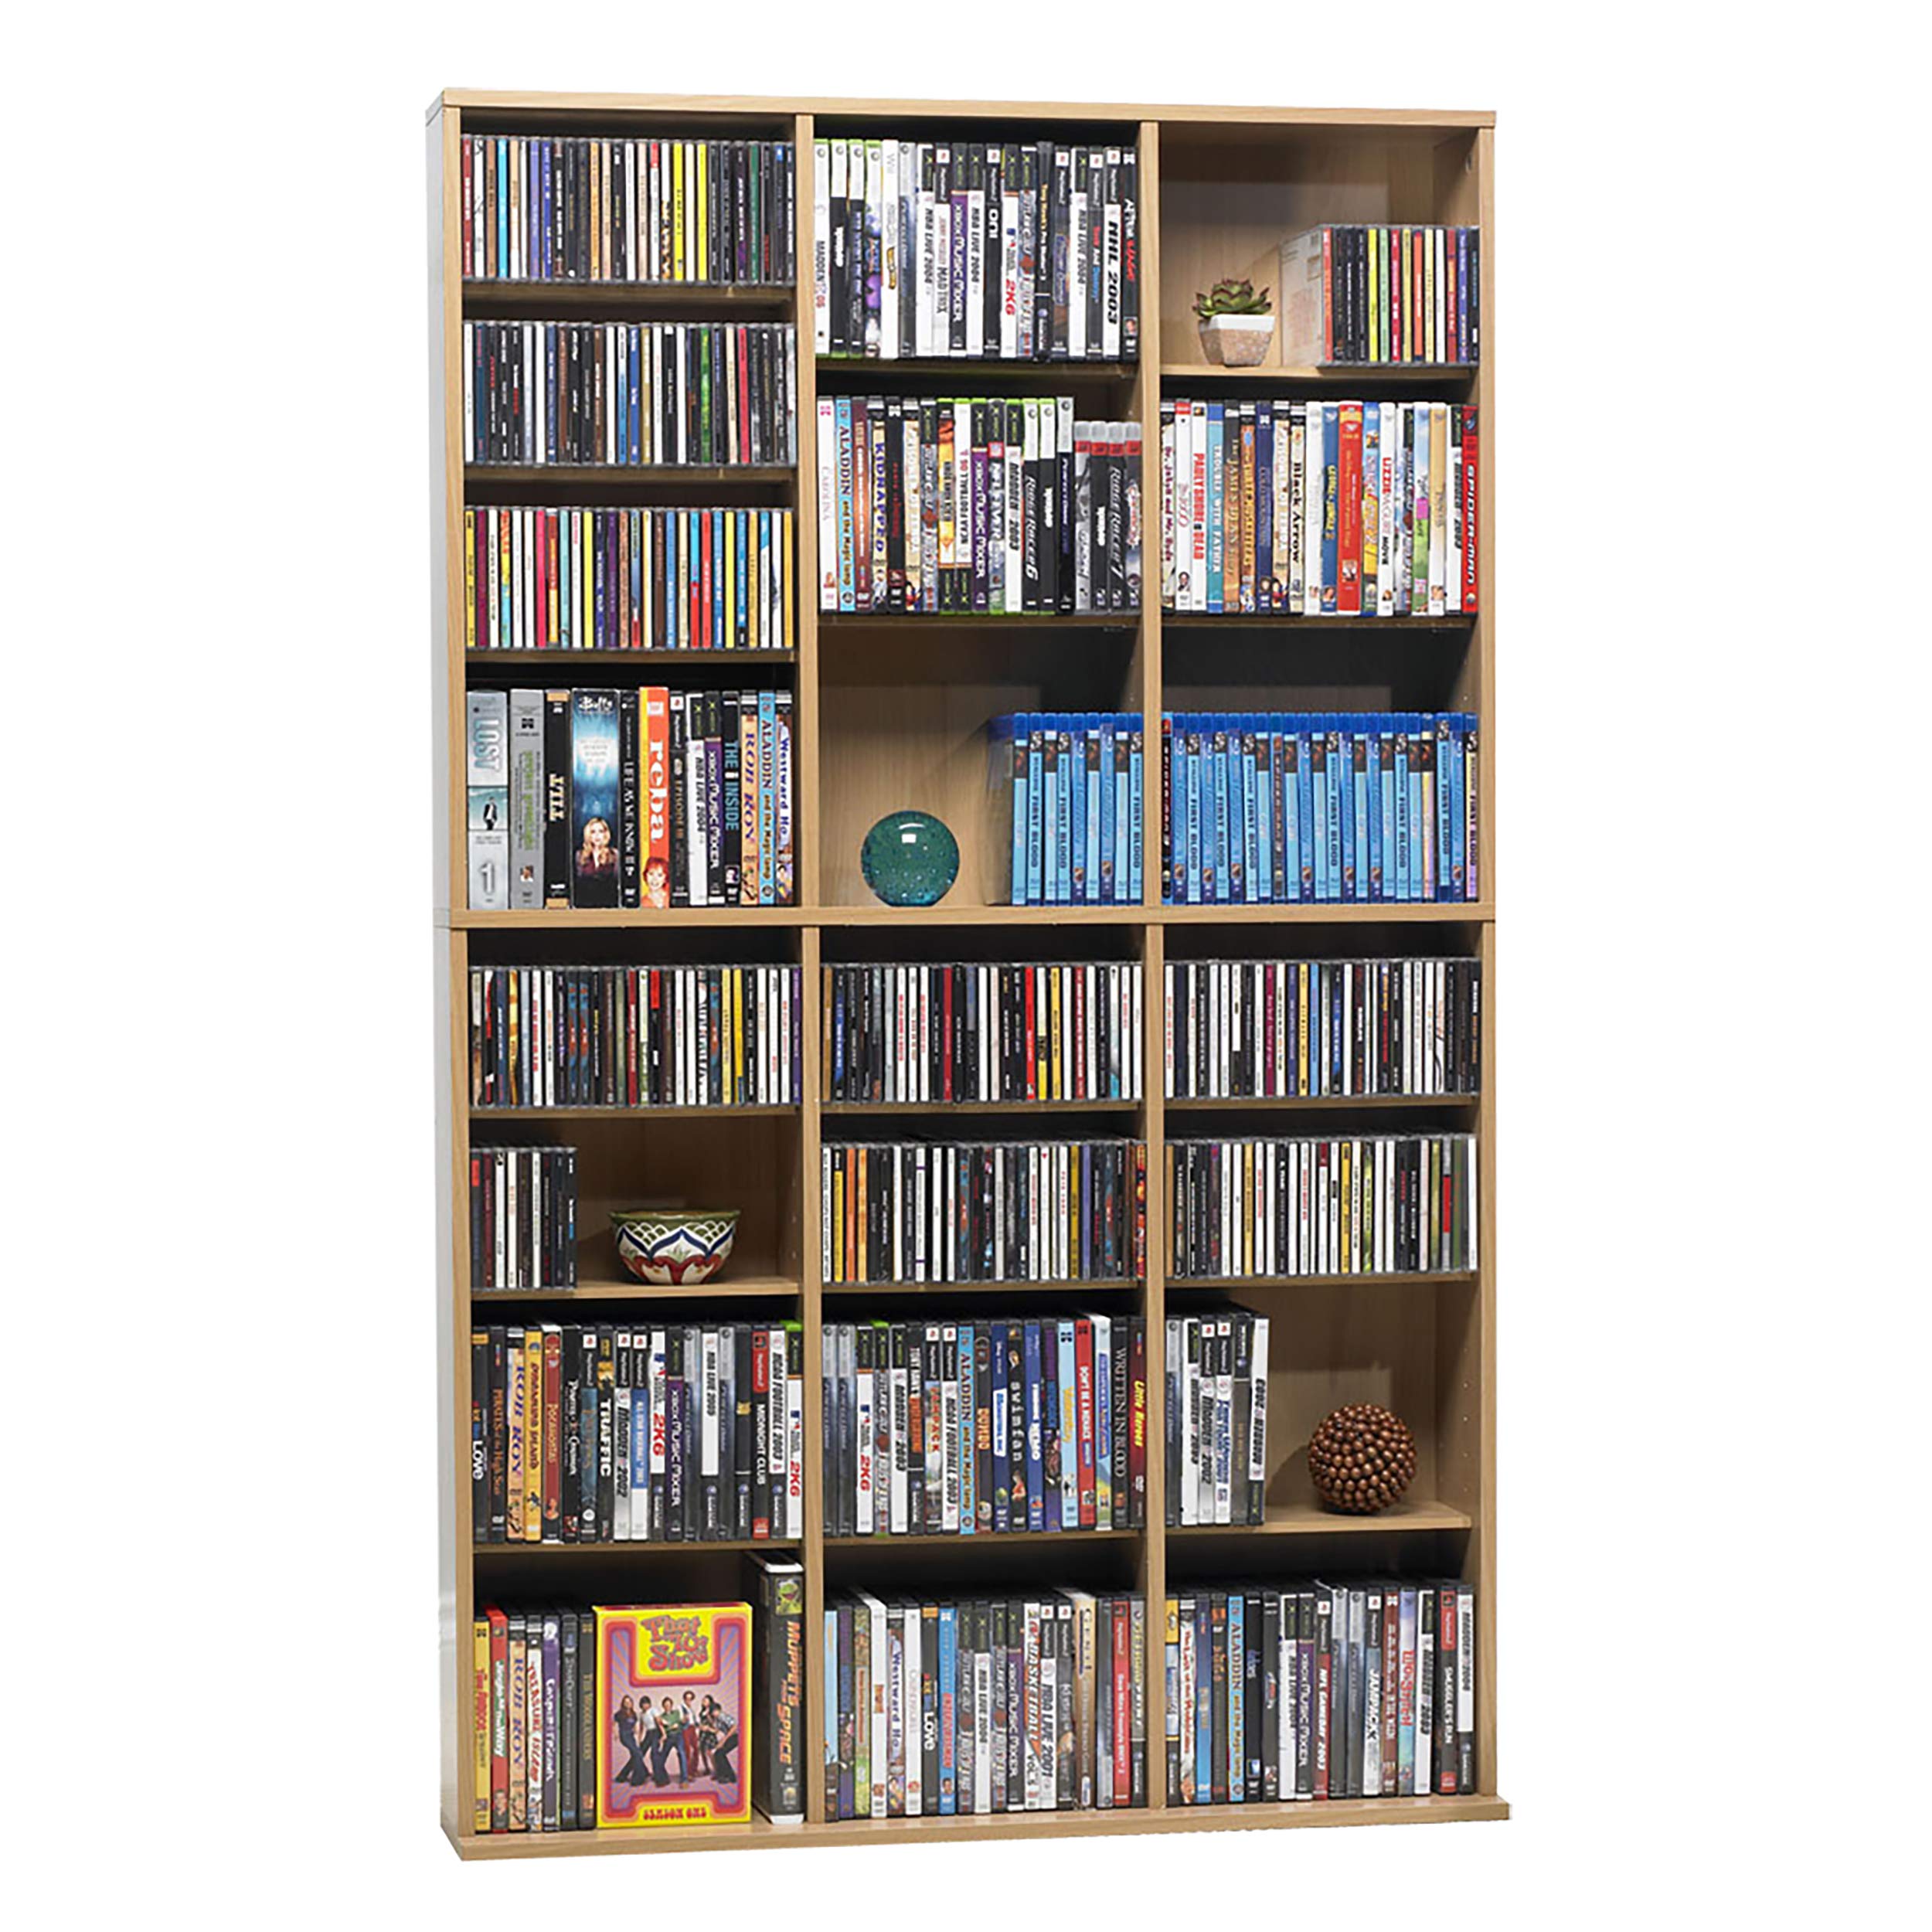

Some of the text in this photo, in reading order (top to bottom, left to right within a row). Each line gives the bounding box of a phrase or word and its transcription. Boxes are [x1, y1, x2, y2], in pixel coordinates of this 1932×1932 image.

[1006, 279, 1015, 315] 2K6
[1108, 220, 1117, 325] NHL 2003
[840, 426, 850, 495] ALADDIN
[876, 442, 885, 553] KIDNAPPED
[1292, 462, 1302, 563] Black Arrow
[473, 718, 500, 772] LOST
[761, 719, 771, 789] ALADDIN
[780, 737, 789, 809] Westward
[549, 774, 564, 821] TILT
[649, 740, 668, 843] reba
[725, 740, 739, 831] THE INSIDE
[931, 1387, 940, 1453] JAMPACK
[961, 1353, 971, 1421] ALADDIN
[1115, 1348, 1126, 1476] WRITTEN IN BLOOD
[1134, 1380, 1145, 1407] Little
[547, 1403, 558, 1463] POCAHONTAS
[600, 1399, 611, 1477] TRAFFIC
[653, 1413, 665, 1457] 2K6
[757, 1404, 765, 1455] MIDNIGHT
[1011, 1382, 1023, 1461] swimfan
[791, 1461, 800, 1497] 2K6
[860, 1454, 870, 1492] 2K6
[641, 1615, 702, 1641] That
[648, 1636, 709, 1672] Show
[1231, 1623, 1242, 1690] ALADDIN
[777, 1621, 801, 1764] MUPPETS SPACE
[1042, 1684, 1053, 1777] NBA LIVE 2001
